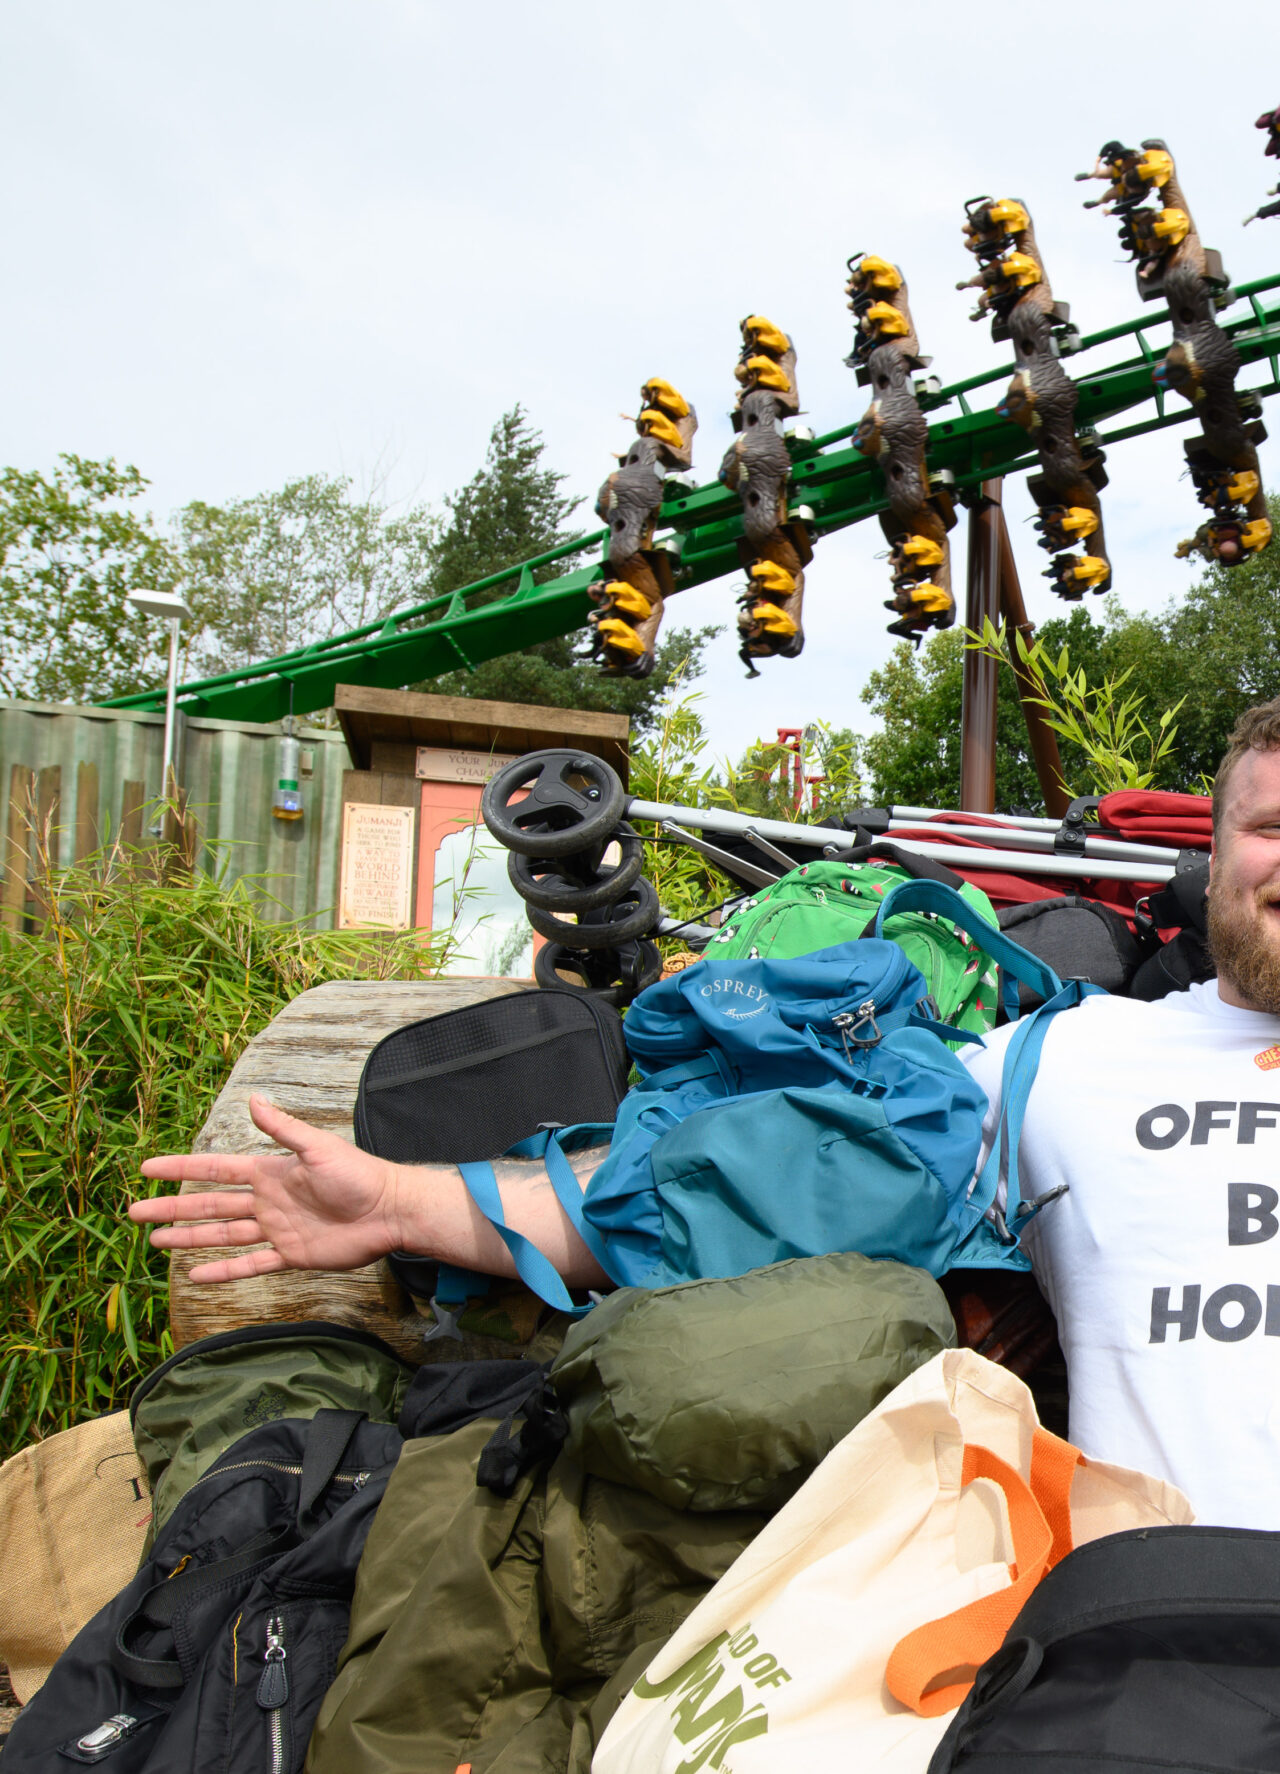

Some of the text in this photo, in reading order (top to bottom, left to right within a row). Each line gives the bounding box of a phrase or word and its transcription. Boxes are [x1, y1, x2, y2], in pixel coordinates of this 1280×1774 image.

[449, 755, 509, 767] YOUR JUM
[456, 768, 494, 777] CHARA
[356, 816, 402, 827] JUMANJI
[354, 861, 401, 872] WORLD
[354, 870, 400, 881] BEHIND
[700, 979, 769, 1002] OSPREY
[743, 1653, 792, 1689] OF
